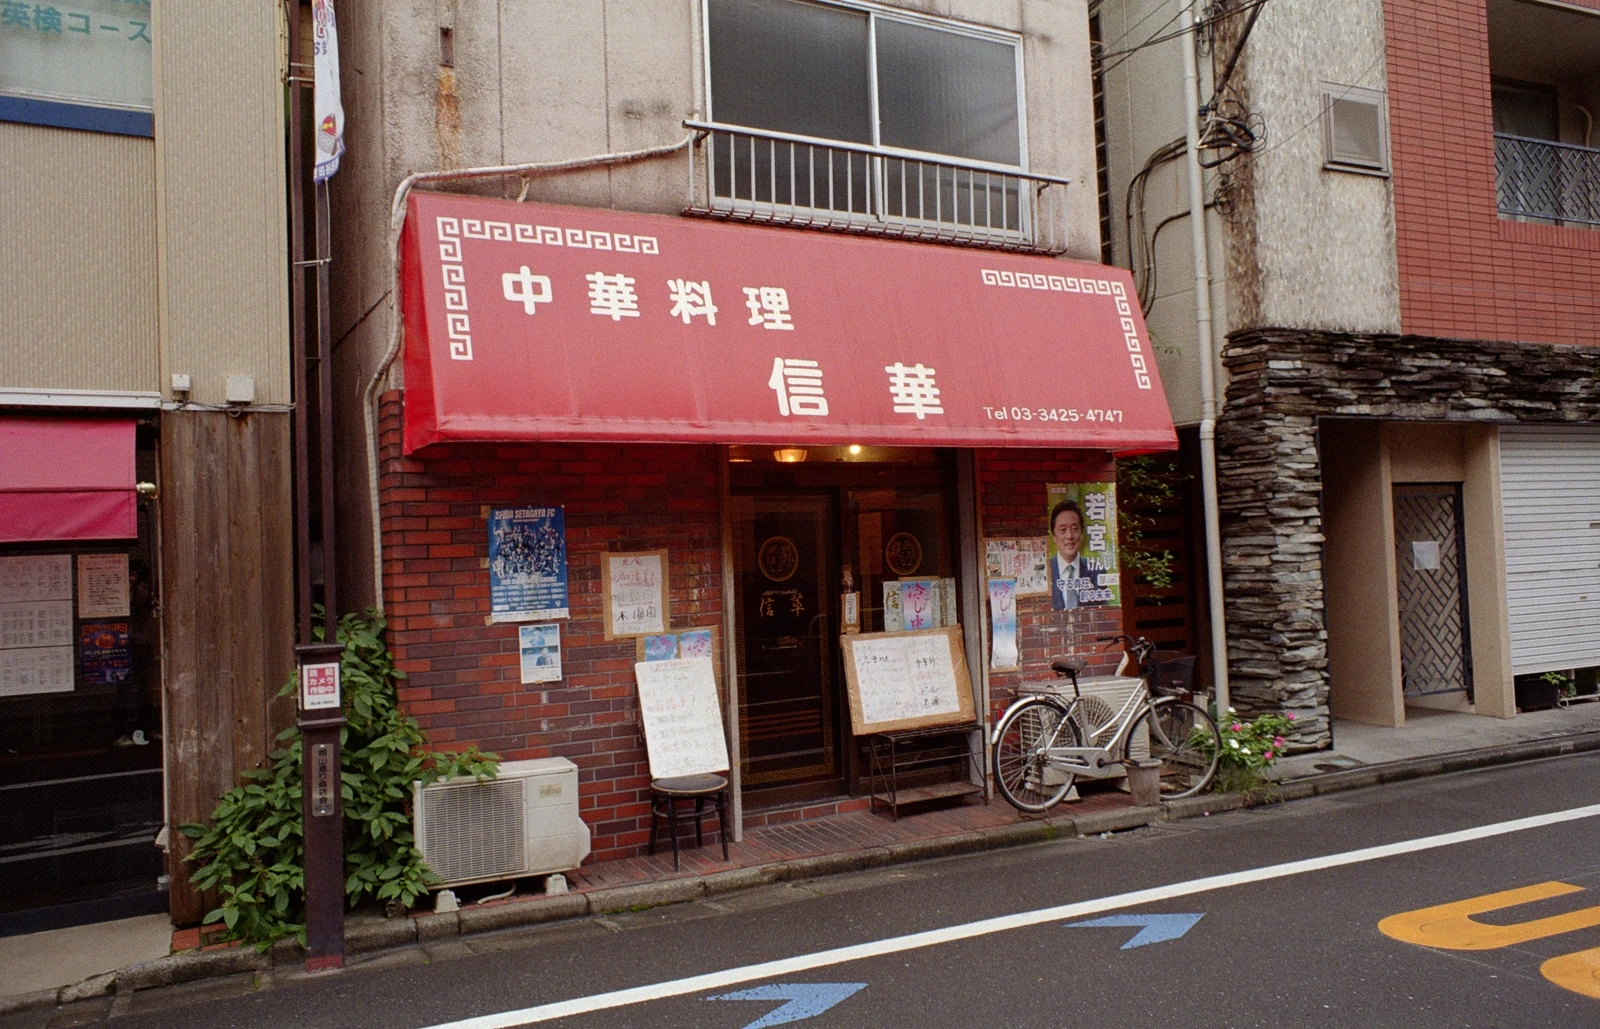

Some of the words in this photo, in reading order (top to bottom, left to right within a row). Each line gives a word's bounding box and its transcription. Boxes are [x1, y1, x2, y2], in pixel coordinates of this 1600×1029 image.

[0, 1, 152, 43] 英検コース
[502, 265, 795, 331] 中華料理
[768, 357, 944, 420] 信華
[983, 406, 1008, 420] Tel
[1011, 407, 1123, 423] 03-3425-4747
[514, 508, 546, 519] SETAGAYA
[547, 508, 556, 518] FC
[1085, 492, 1107, 552] 若宮
[1087, 556, 1111, 571] けんじ
[309, 667, 334, 678] 防犯
[309, 677, 334, 687] カメラ
[309, 685, 335, 696] 作動中
